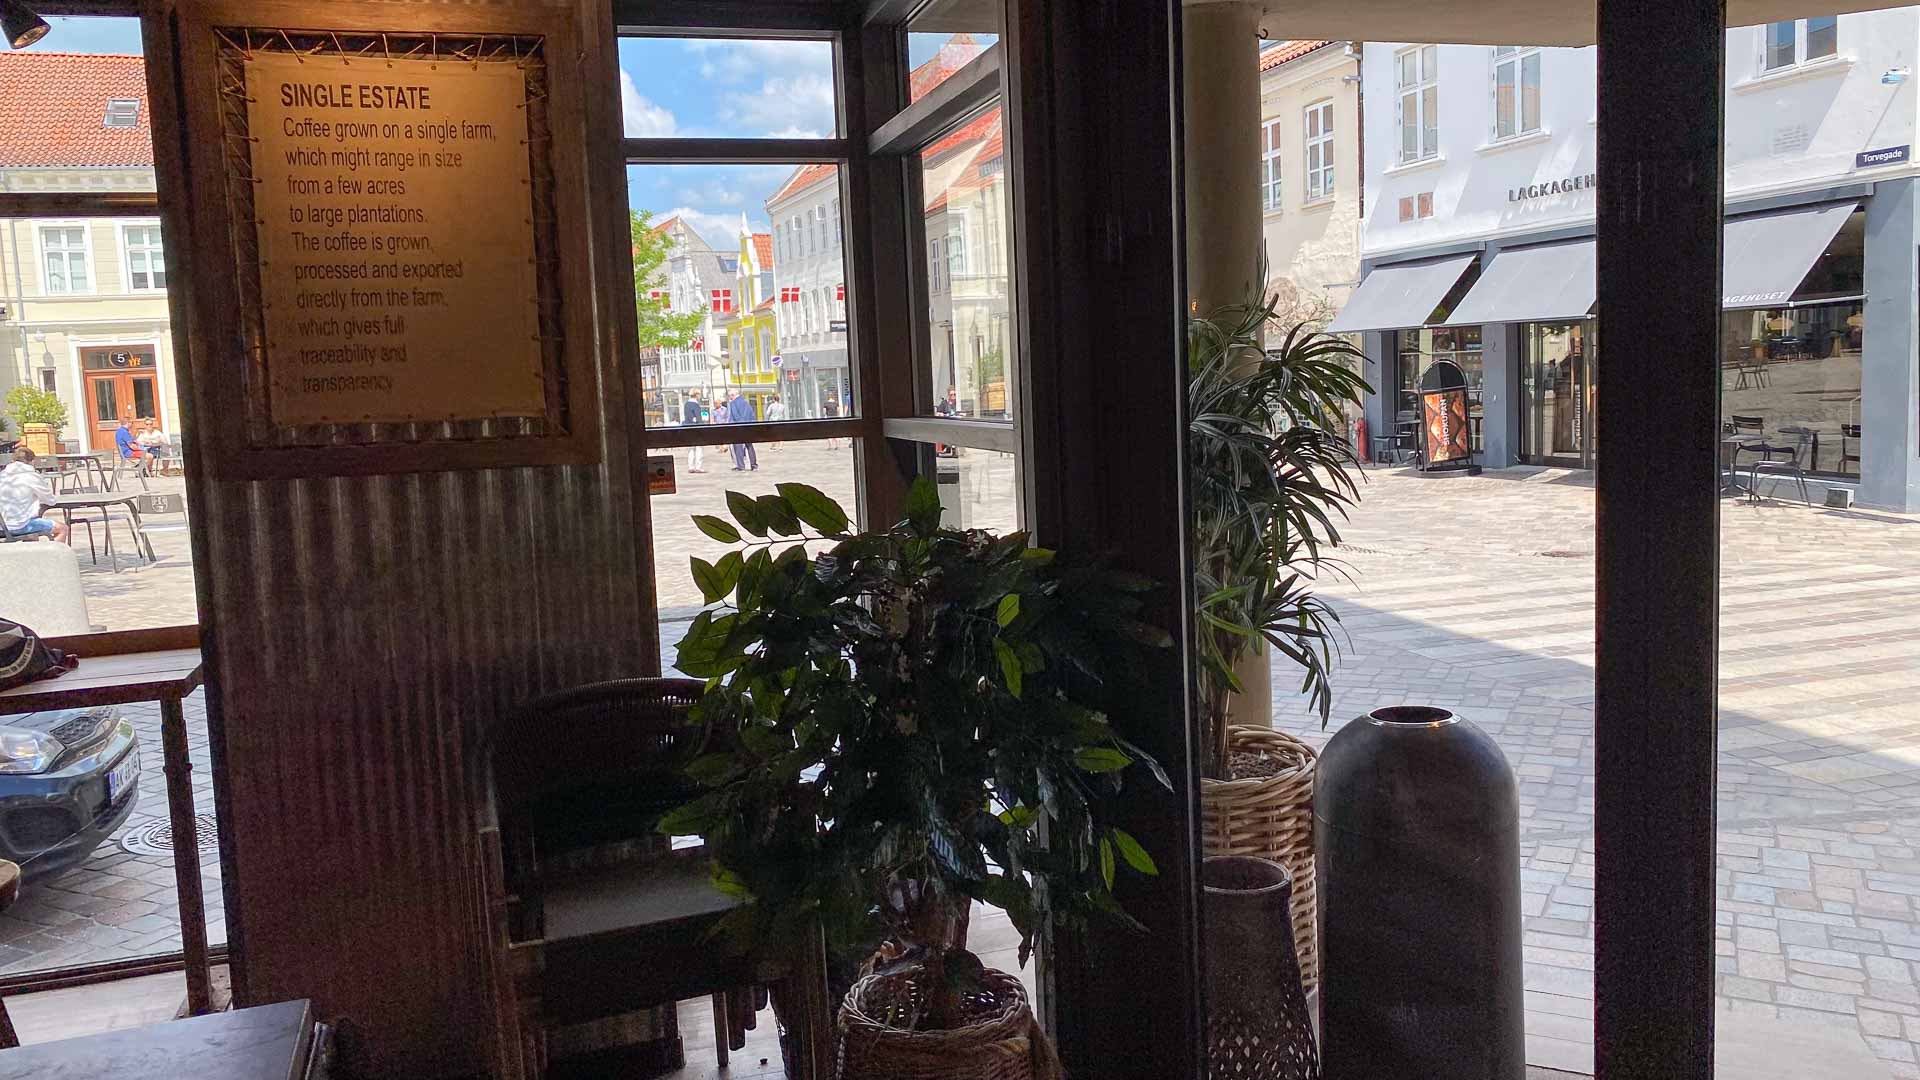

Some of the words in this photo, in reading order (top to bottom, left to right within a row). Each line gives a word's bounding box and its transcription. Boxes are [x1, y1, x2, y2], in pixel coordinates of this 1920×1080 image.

[281, 83, 353, 107] SINGLE
[359, 86, 431, 109] ESTATE
[283, 117, 330, 138] Coffee
[335, 123, 378, 142] grown
[382, 124, 399, 140] on
[404, 125, 413, 140] a
[417, 120, 457, 144] single
[461, 120, 496, 142] farm,
[286, 147, 327, 168] which
[331, 148, 370, 171] might
[374, 151, 414, 172] range
[419, 150, 431, 168] in
[435, 150, 462, 168] size
[1863, 149, 1903, 163] Torvegade
[288, 174, 320, 194] from
[325, 179, 333, 194] a
[337, 174, 362, 194] few
[367, 179, 405, 194] acres
[1508, 173, 1596, 202] LAGKAGEH
[290, 205, 303, 223] to
[307, 204, 343, 227] large
[348, 203, 427, 225] plantations.
[292, 231, 320, 251] The
[324, 231, 366, 251] coffee
[371, 231, 383, 250] is
[295, 260, 367, 283] processed
[372, 260, 398, 279] and
[402, 258, 463, 280] exported
[297, 289, 346, 311] directly
[351, 288, 382, 307] from
[387, 288, 408, 306] the
[298, 317, 339, 337] which
[344, 320, 381, 339] gives
[385, 315, 405, 334] full
[117, 353, 126, 363] 5
[300, 343, 375, 366] traceability
[381, 344, 407, 363] and
[303, 374, 392, 393] transparency
[1440, 399, 1450, 446] SHOKUPAN
